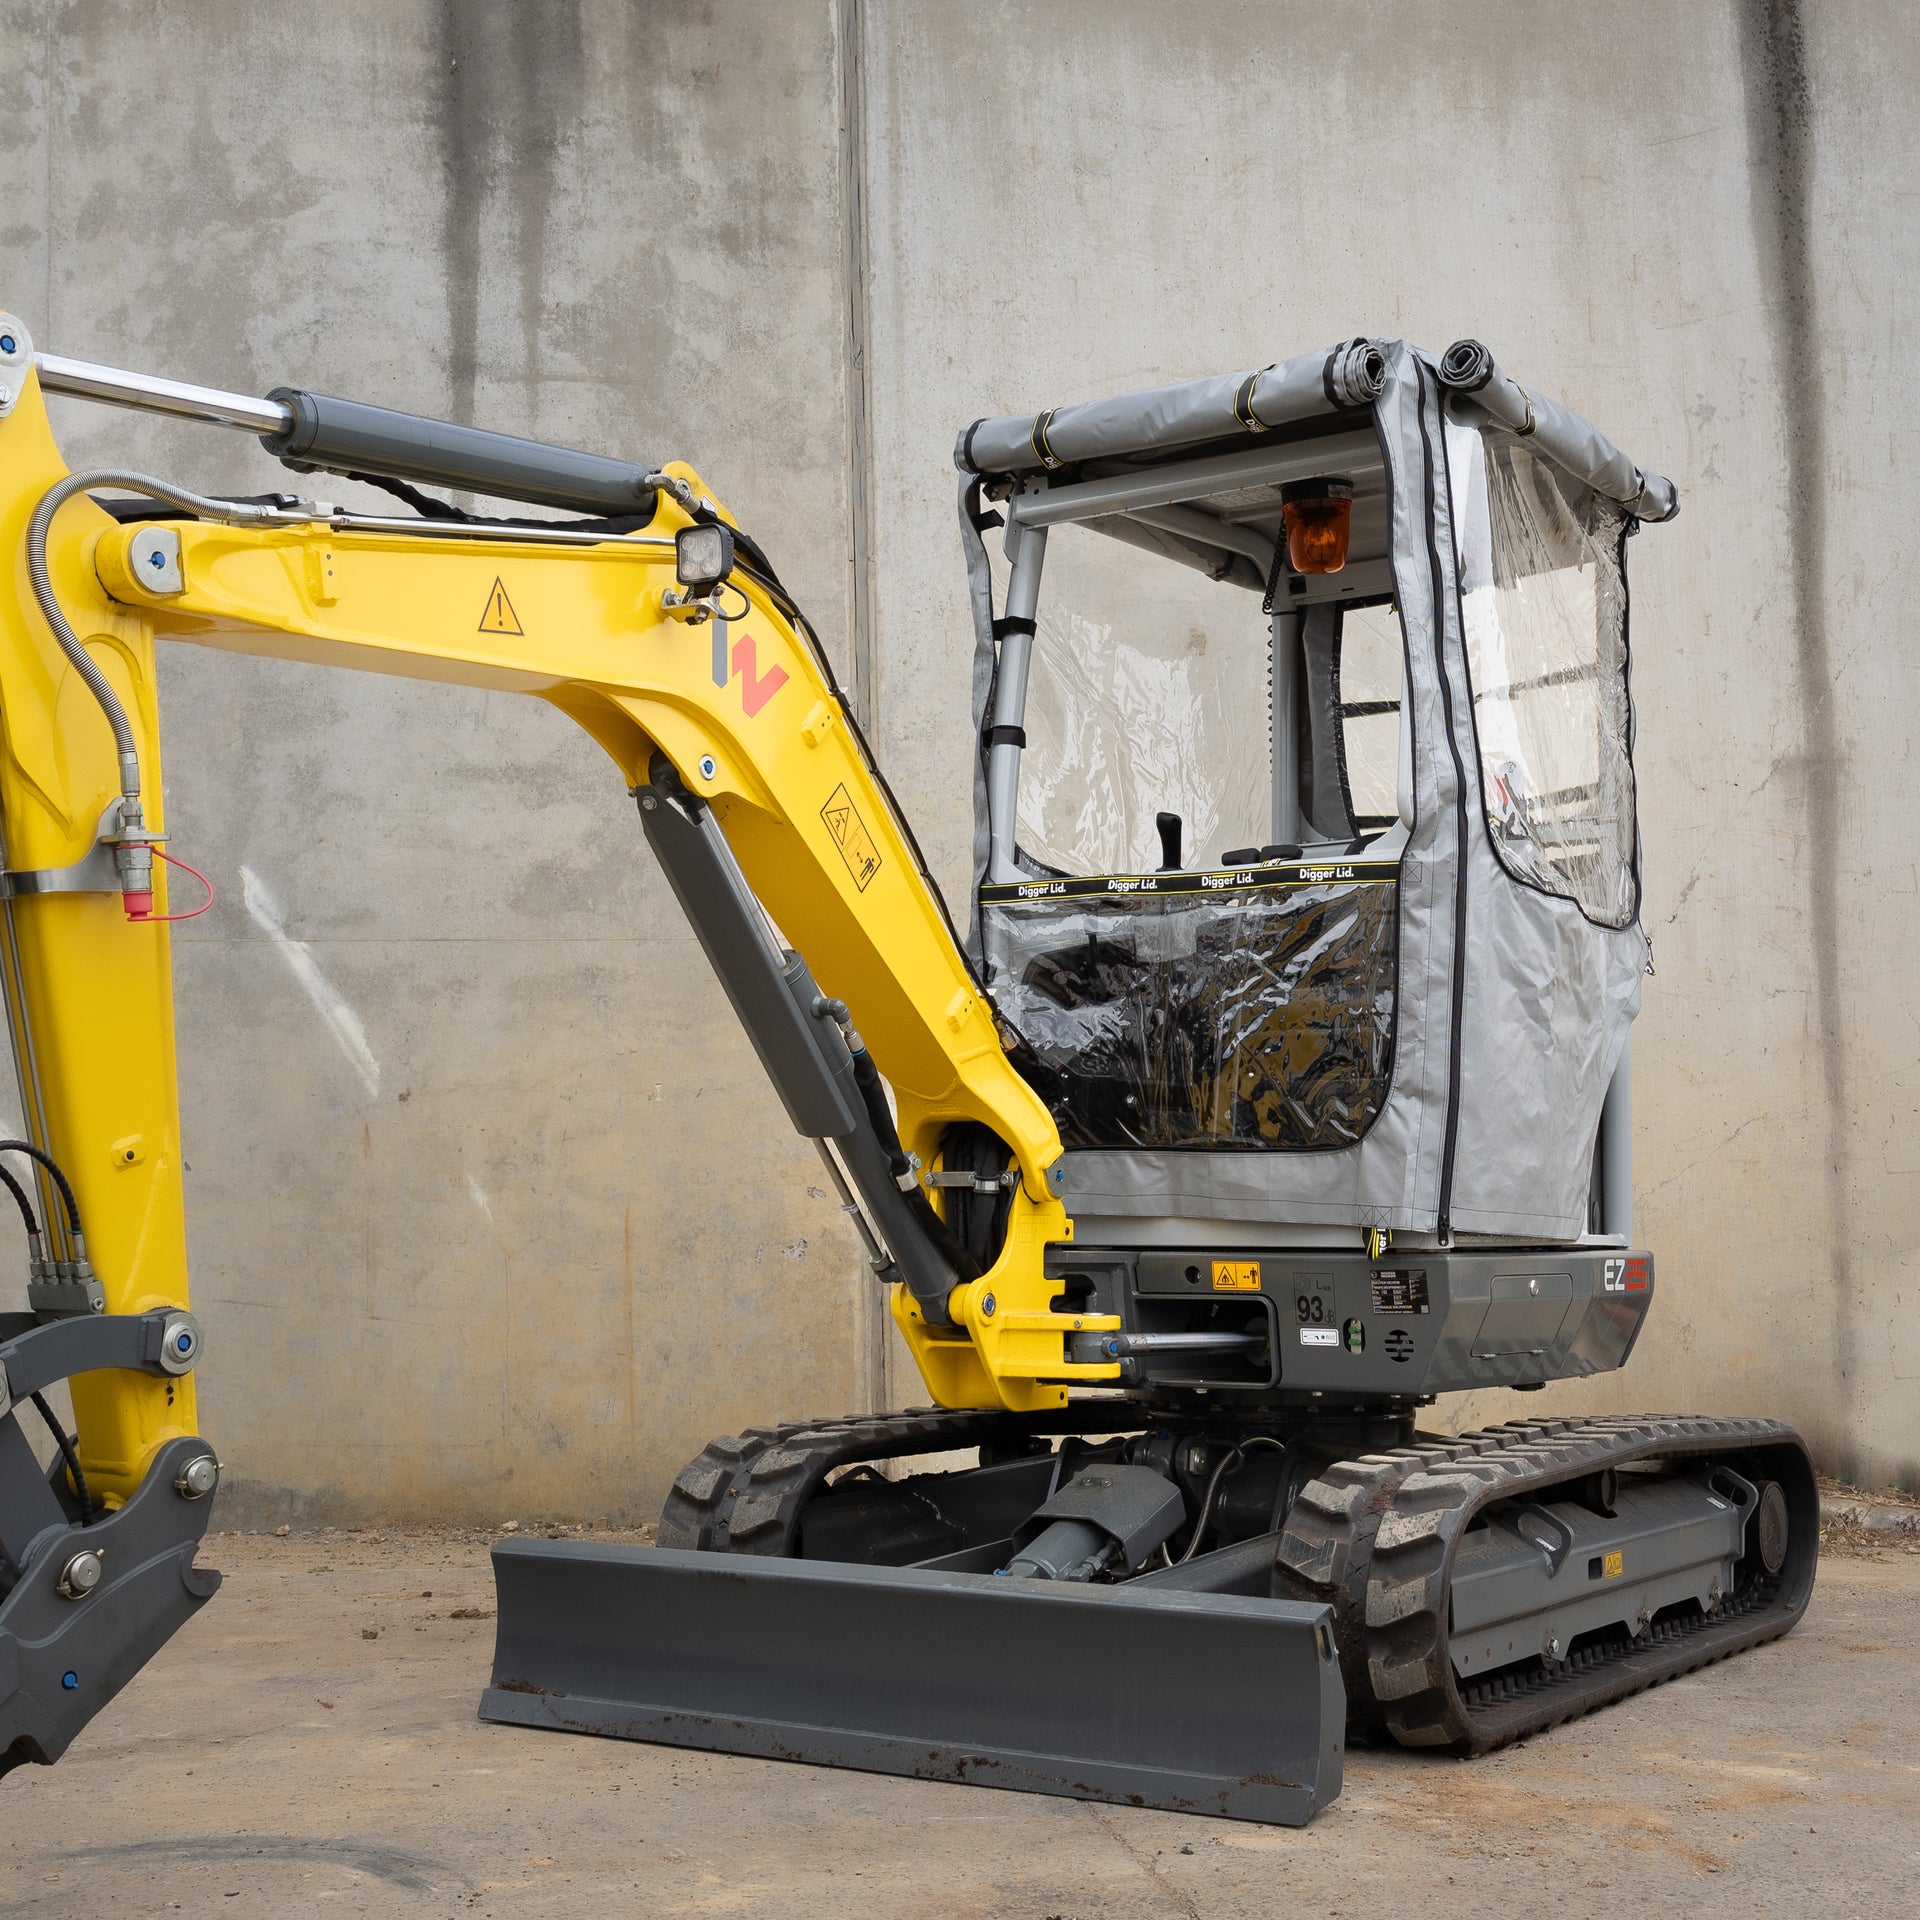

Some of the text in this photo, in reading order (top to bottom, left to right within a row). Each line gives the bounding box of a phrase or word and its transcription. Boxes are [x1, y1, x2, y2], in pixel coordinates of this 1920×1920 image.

[1201, 872, 1255, 888] Digger Lid.
[1299, 866, 1355, 881] Digger Lid.
[1018, 882, 1067, 898] Digger Lid.
[1107, 878, 1158, 892] Digger Lid.
[1296, 1295, 1324, 1323] 93
